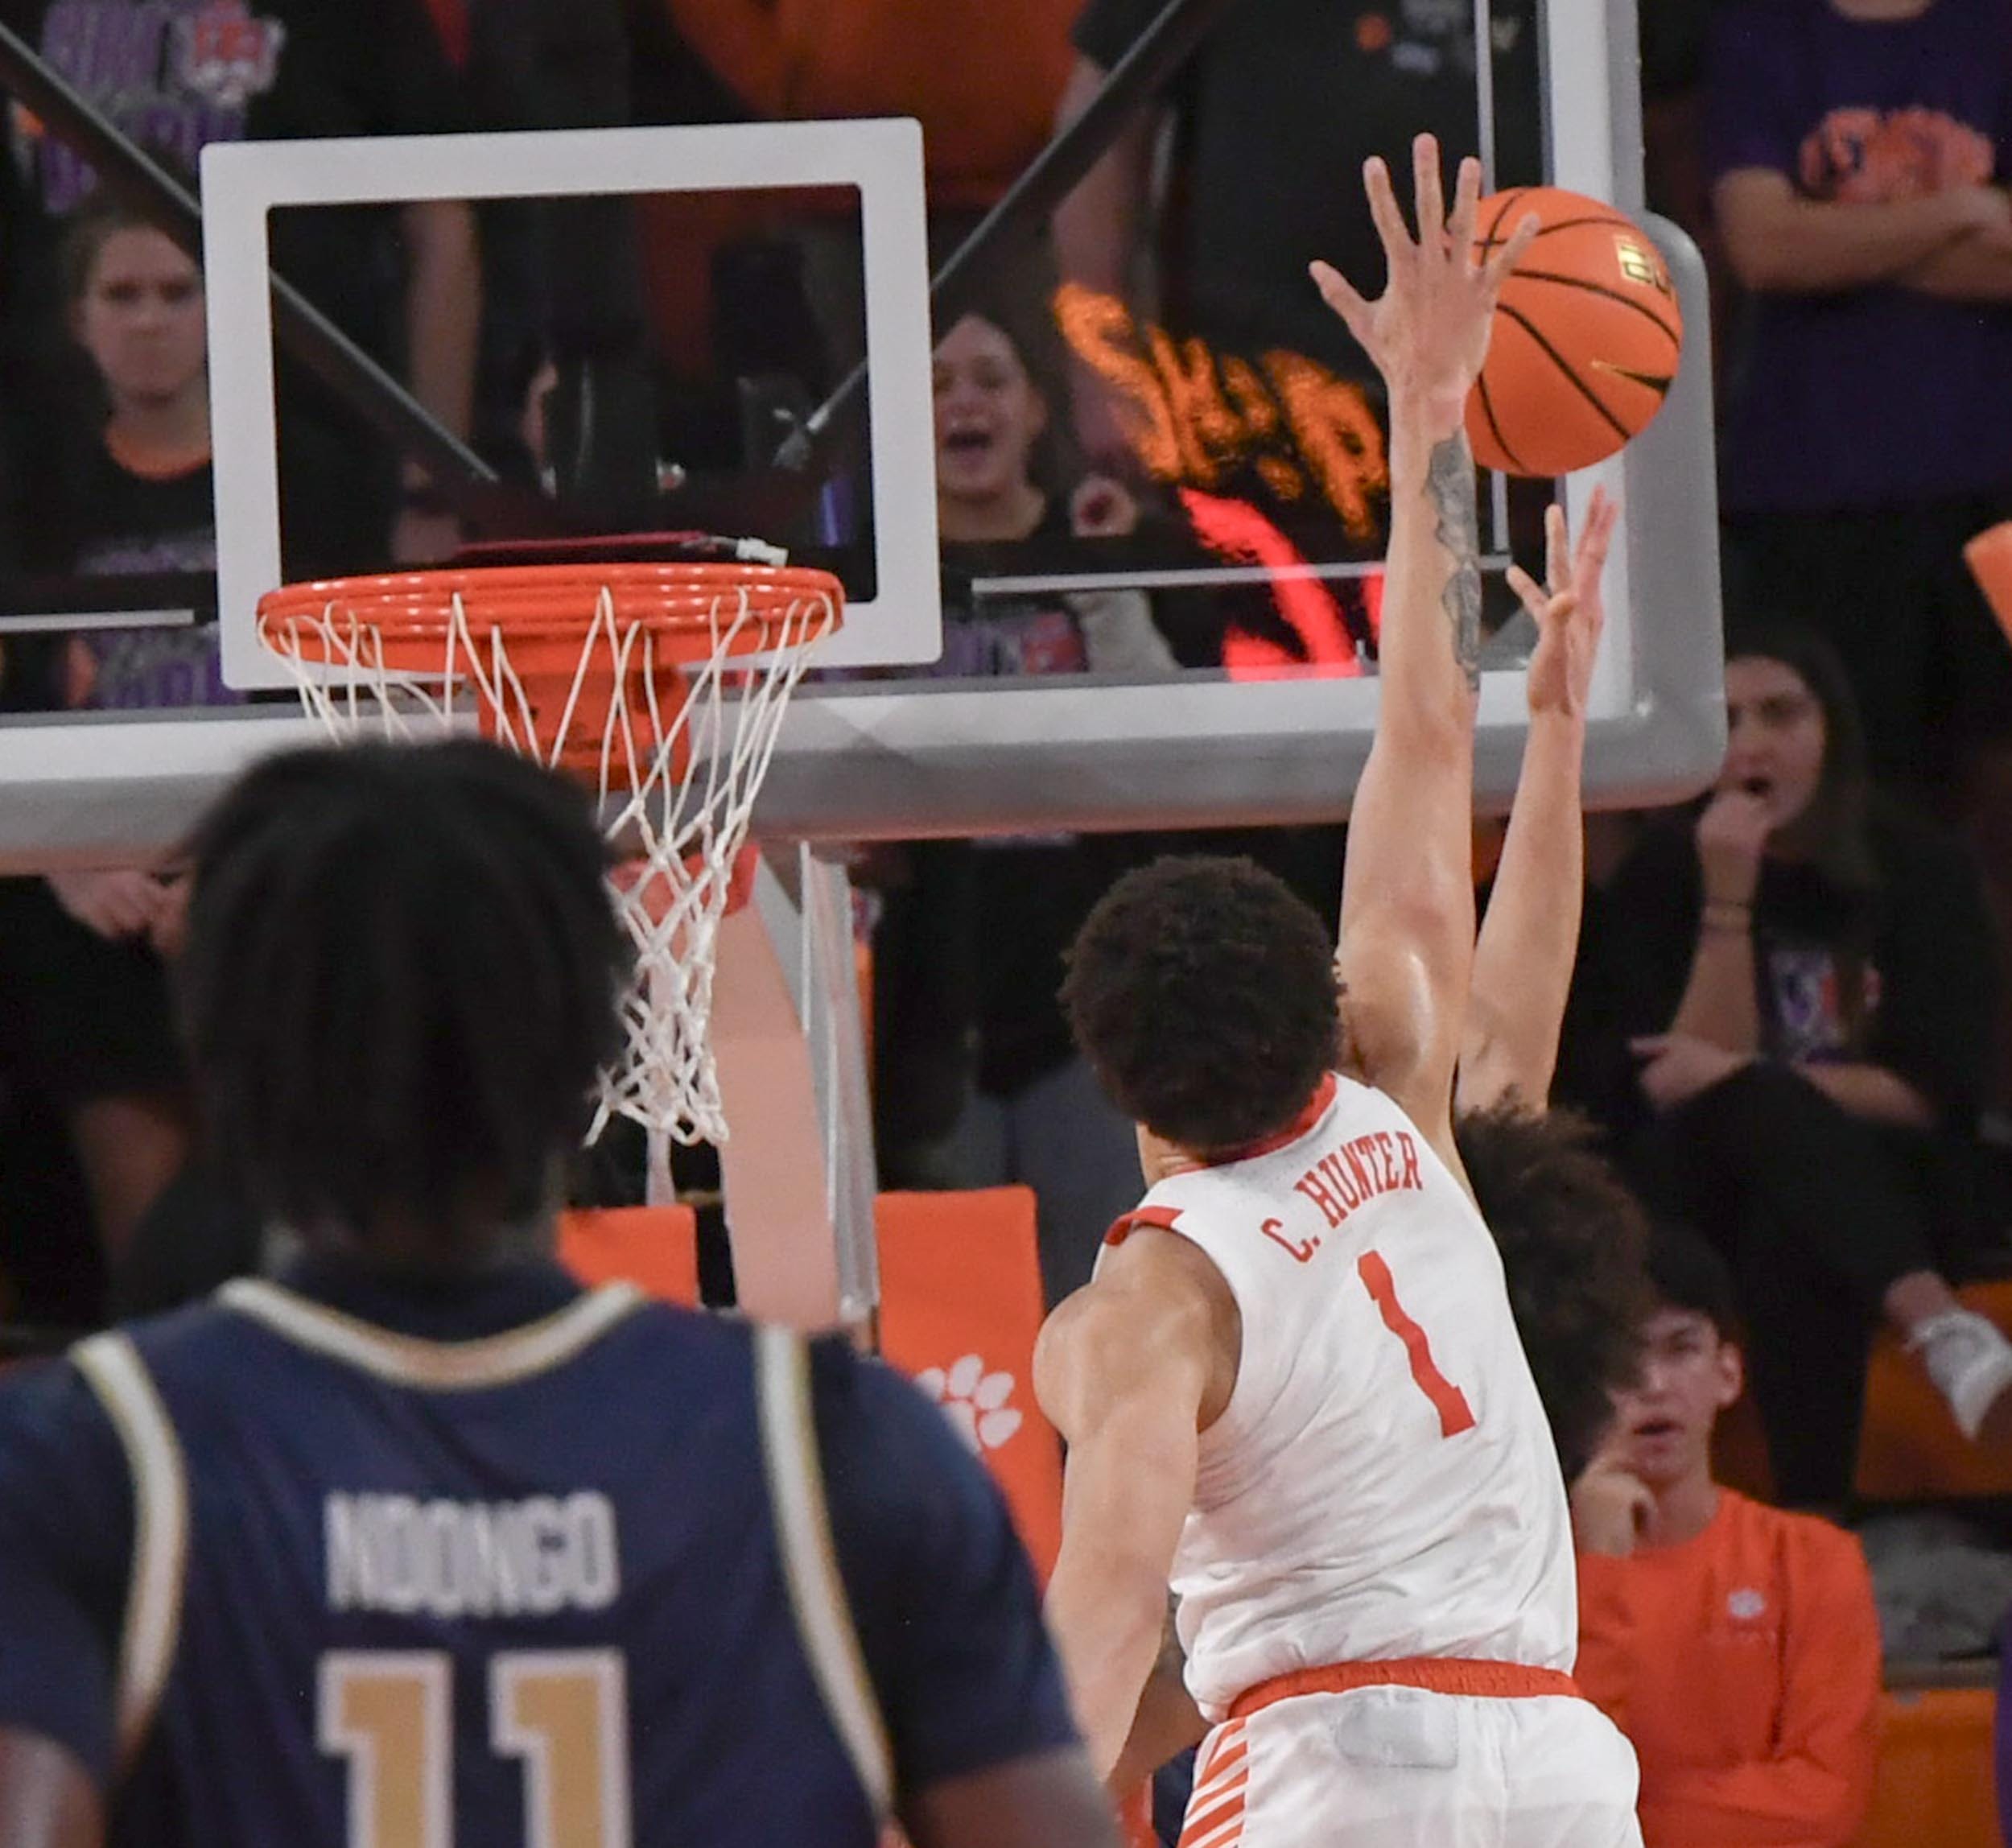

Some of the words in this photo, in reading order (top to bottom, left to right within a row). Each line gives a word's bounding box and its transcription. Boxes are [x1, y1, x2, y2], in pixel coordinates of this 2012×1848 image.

[1260, 1218, 1321, 1263] C.
[1293, 1131, 1423, 1228] HUNTER
[1357, 1249, 1476, 1439] 1
[316, 1648, 632, 1848] 11
